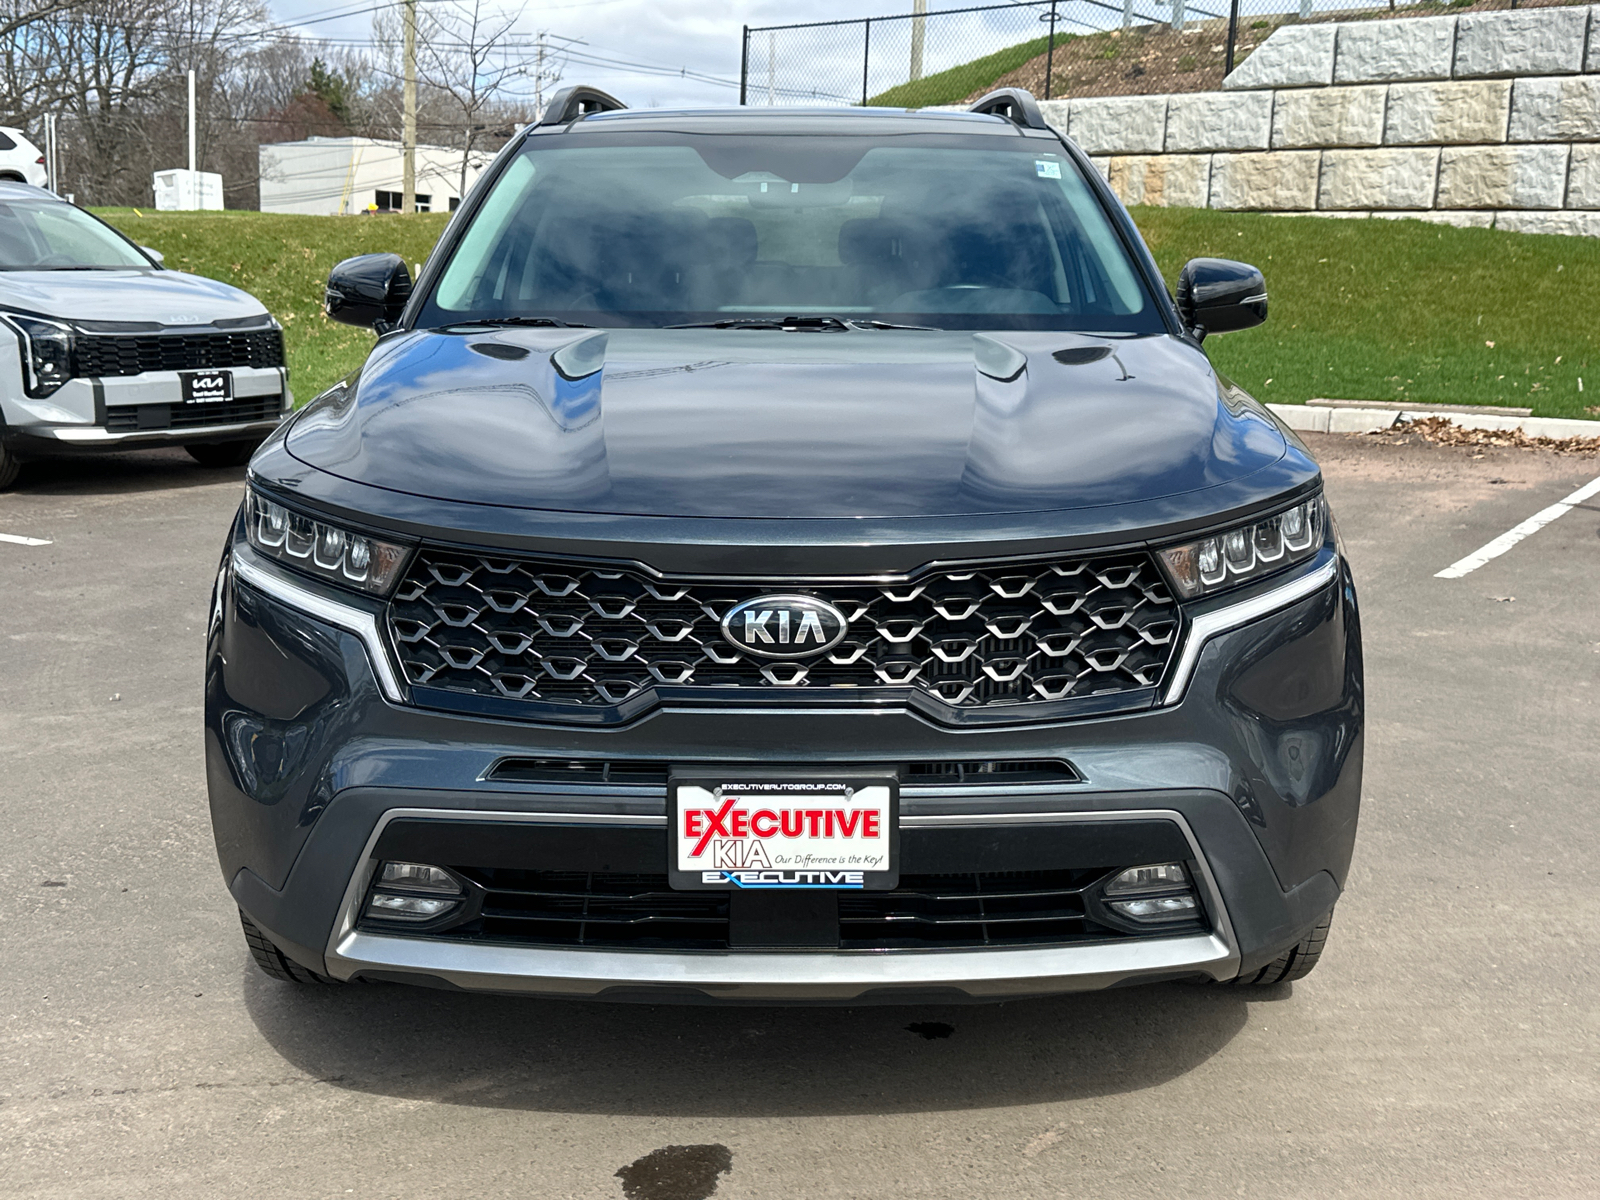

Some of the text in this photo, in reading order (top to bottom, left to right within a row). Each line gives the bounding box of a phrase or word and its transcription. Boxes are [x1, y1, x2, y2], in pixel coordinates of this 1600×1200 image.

[192, 377, 223, 389] KIA
[744, 610, 826, 643] KIA
[684, 797, 881, 858] EXECUTIVE
[713, 840, 772, 868] KIA
[774, 853, 884, 868] Our Difference is the Key!
[702, 871, 864, 888] EXECUTIVE
